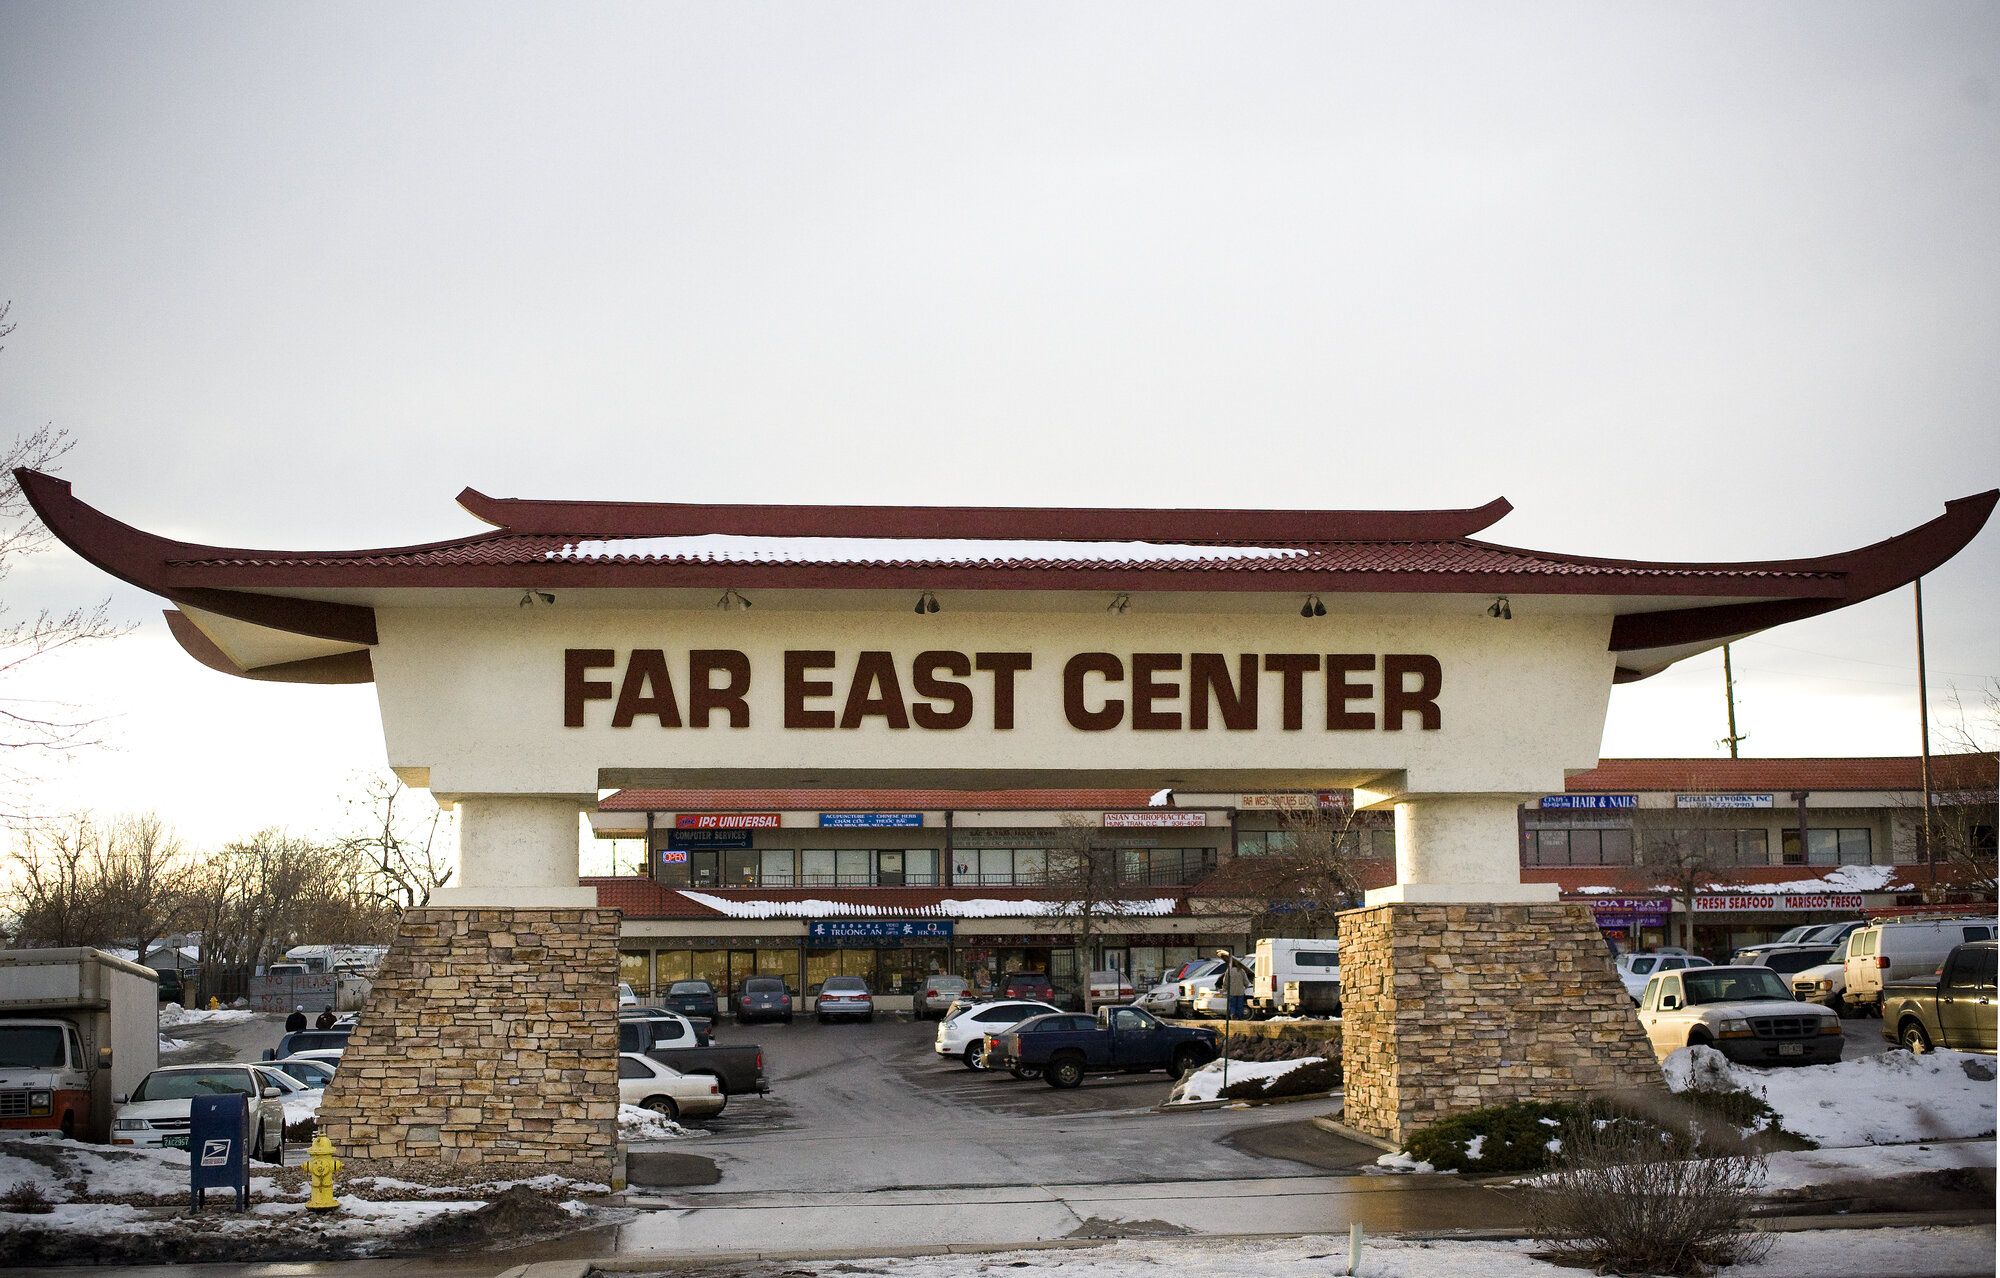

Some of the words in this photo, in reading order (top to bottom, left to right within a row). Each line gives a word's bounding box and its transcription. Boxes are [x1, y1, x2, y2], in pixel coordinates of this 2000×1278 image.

[564, 649, 752, 729] FAR
[783, 650, 1033, 730] EAST
[1063, 652, 1443, 732] CENTER
[1572, 796, 1596, 808] HAIR
[1599, 796, 1606, 808] &
[1609, 796, 1638, 808] NAILS
[698, 816, 717, 828] IPC
[719, 816, 778, 828] UNIVERSAL
[675, 831, 712, 840] COMPUTER
[714, 830, 747, 840] SERVICES
[665, 853, 685, 861] OPEN
[1696, 897, 1726, 909] FRESH
[1728, 897, 1774, 909] SEAFOOD
[1785, 896, 1828, 909] MARISCOS
[1831, 895, 1863, 908] FRESCO
[869, 928, 883, 936] AN
